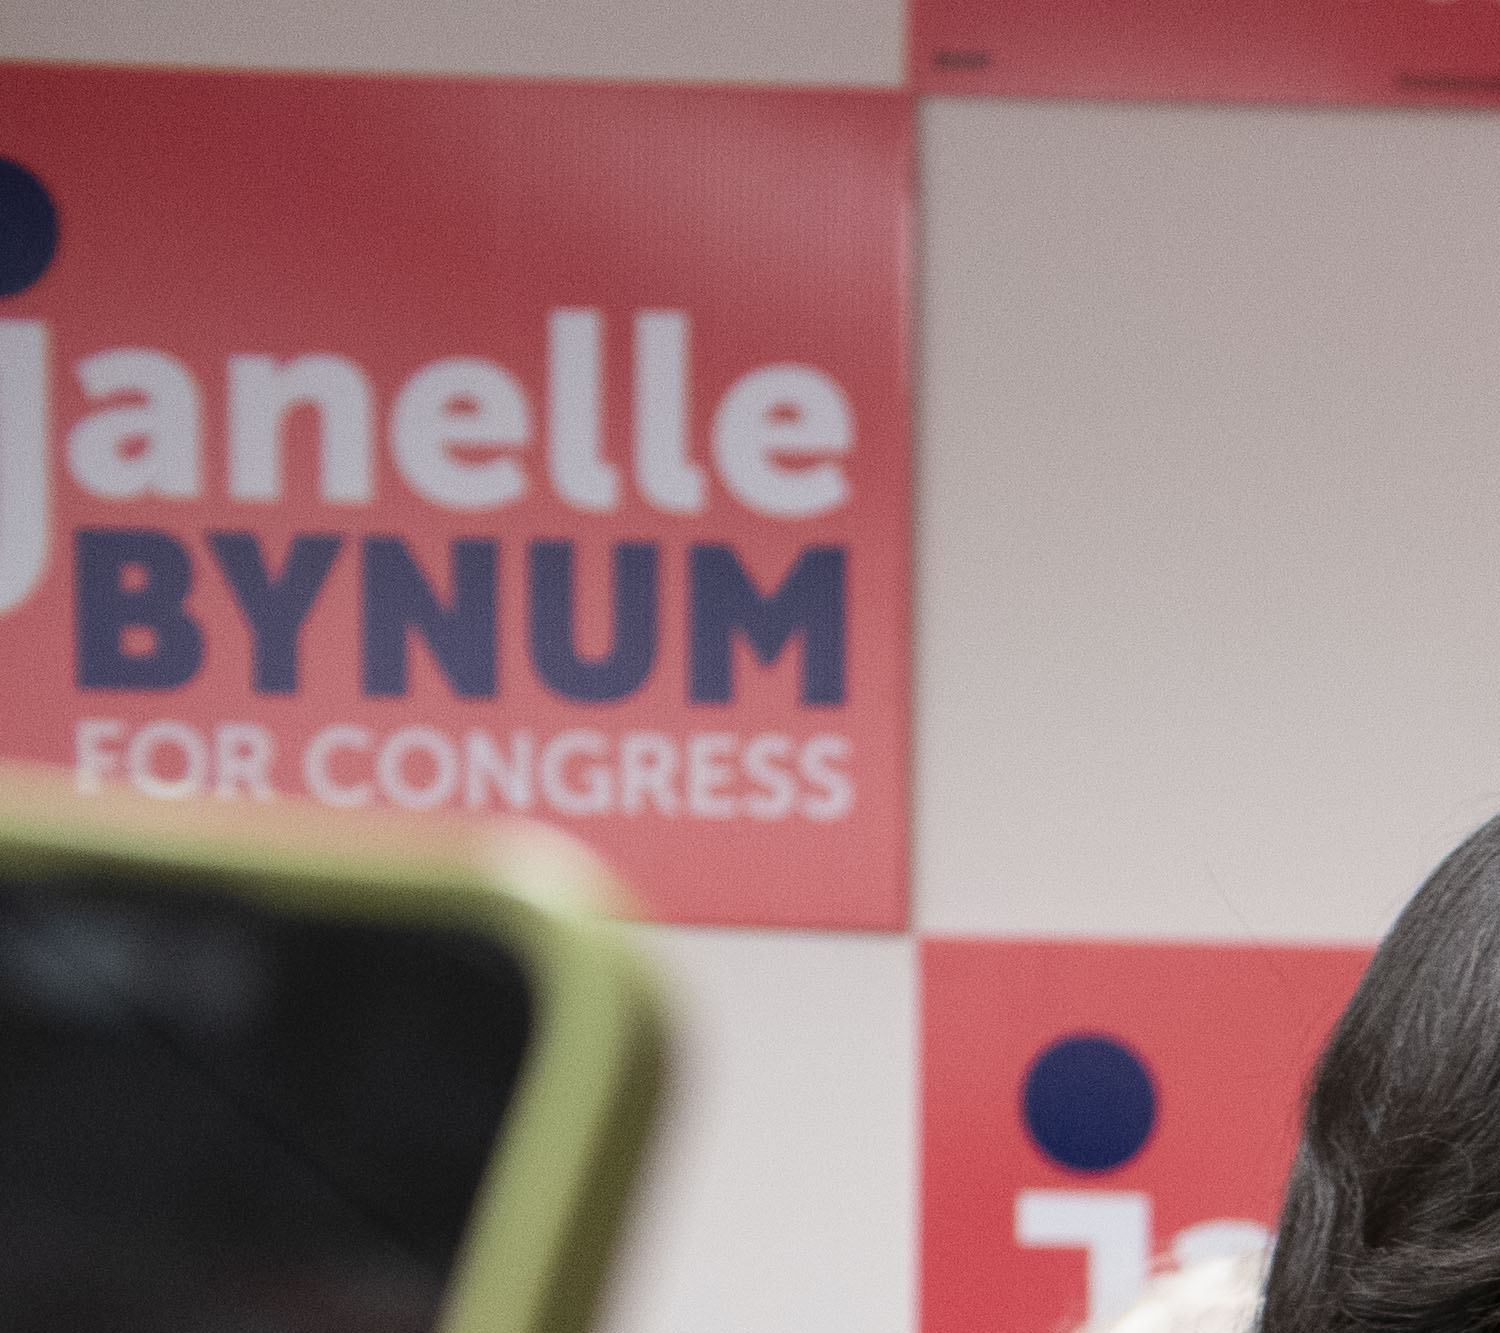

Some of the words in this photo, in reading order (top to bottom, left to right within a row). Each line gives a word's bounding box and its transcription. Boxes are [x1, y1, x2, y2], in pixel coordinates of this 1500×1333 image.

[73, 527, 850, 708] BYNUM
[74, 718, 274, 801] FOR
[302, 725, 856, 821] CONGRESS
